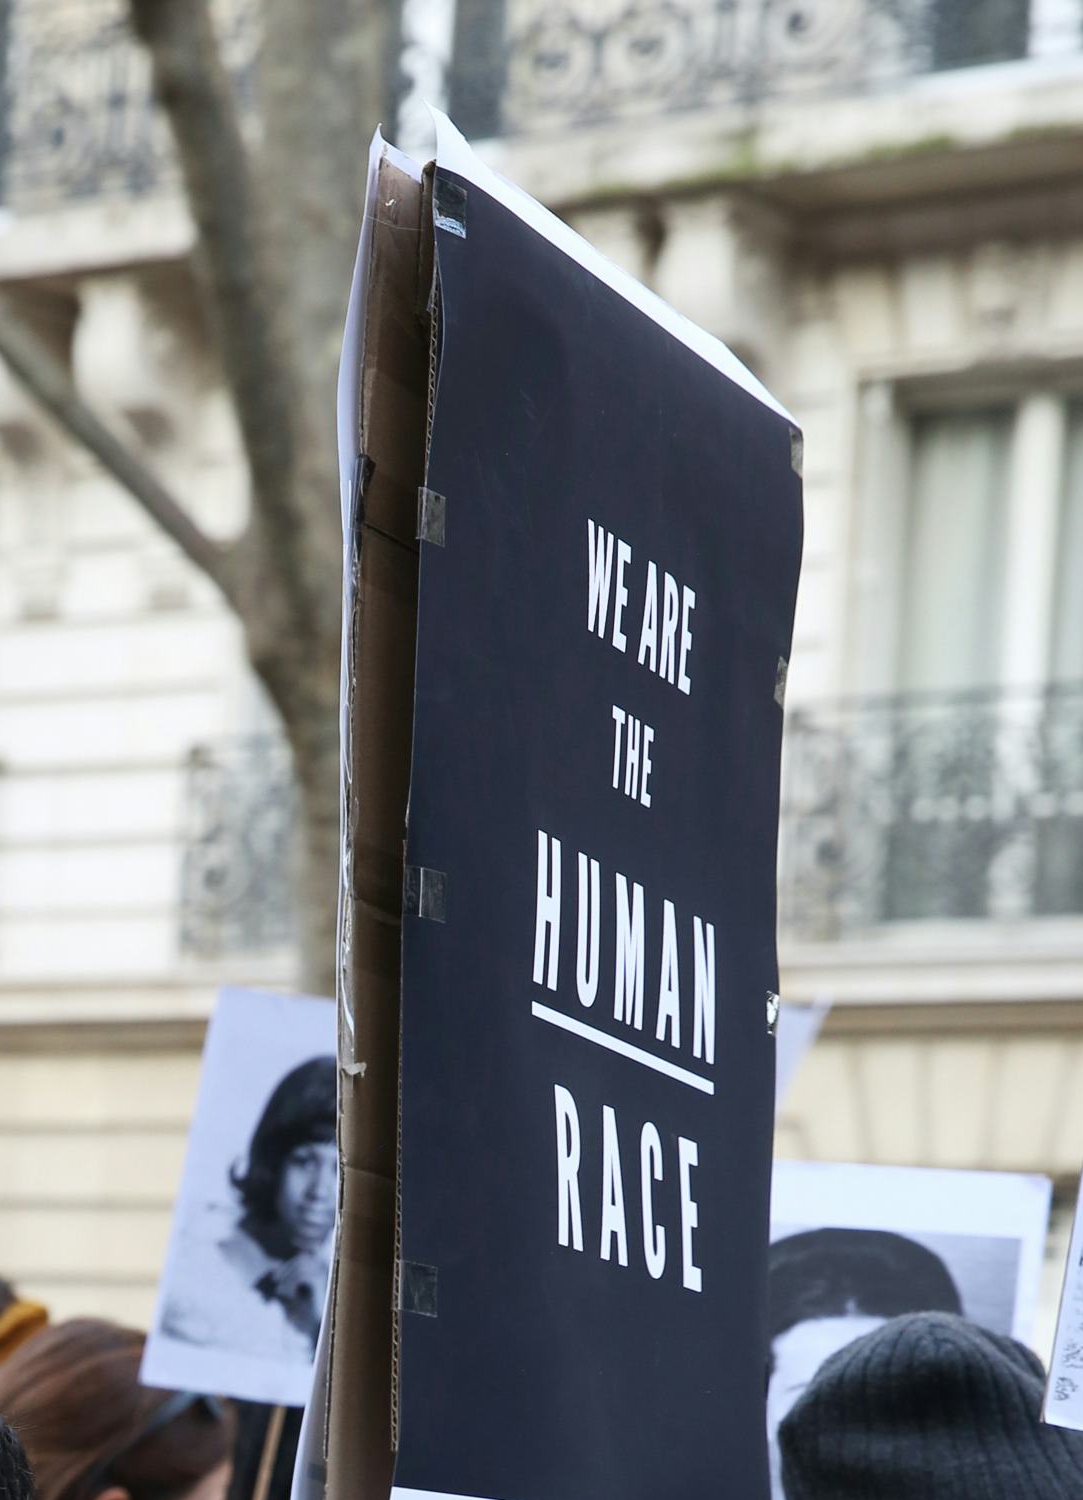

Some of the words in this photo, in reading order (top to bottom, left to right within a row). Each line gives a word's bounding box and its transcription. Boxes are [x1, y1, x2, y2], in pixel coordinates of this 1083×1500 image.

[587, 518, 632, 653] WE
[637, 560, 696, 696] ARE
[612, 705, 655, 808] THE
[532, 829, 716, 1065] HUMAN
[554, 1084, 702, 1293] RACE
